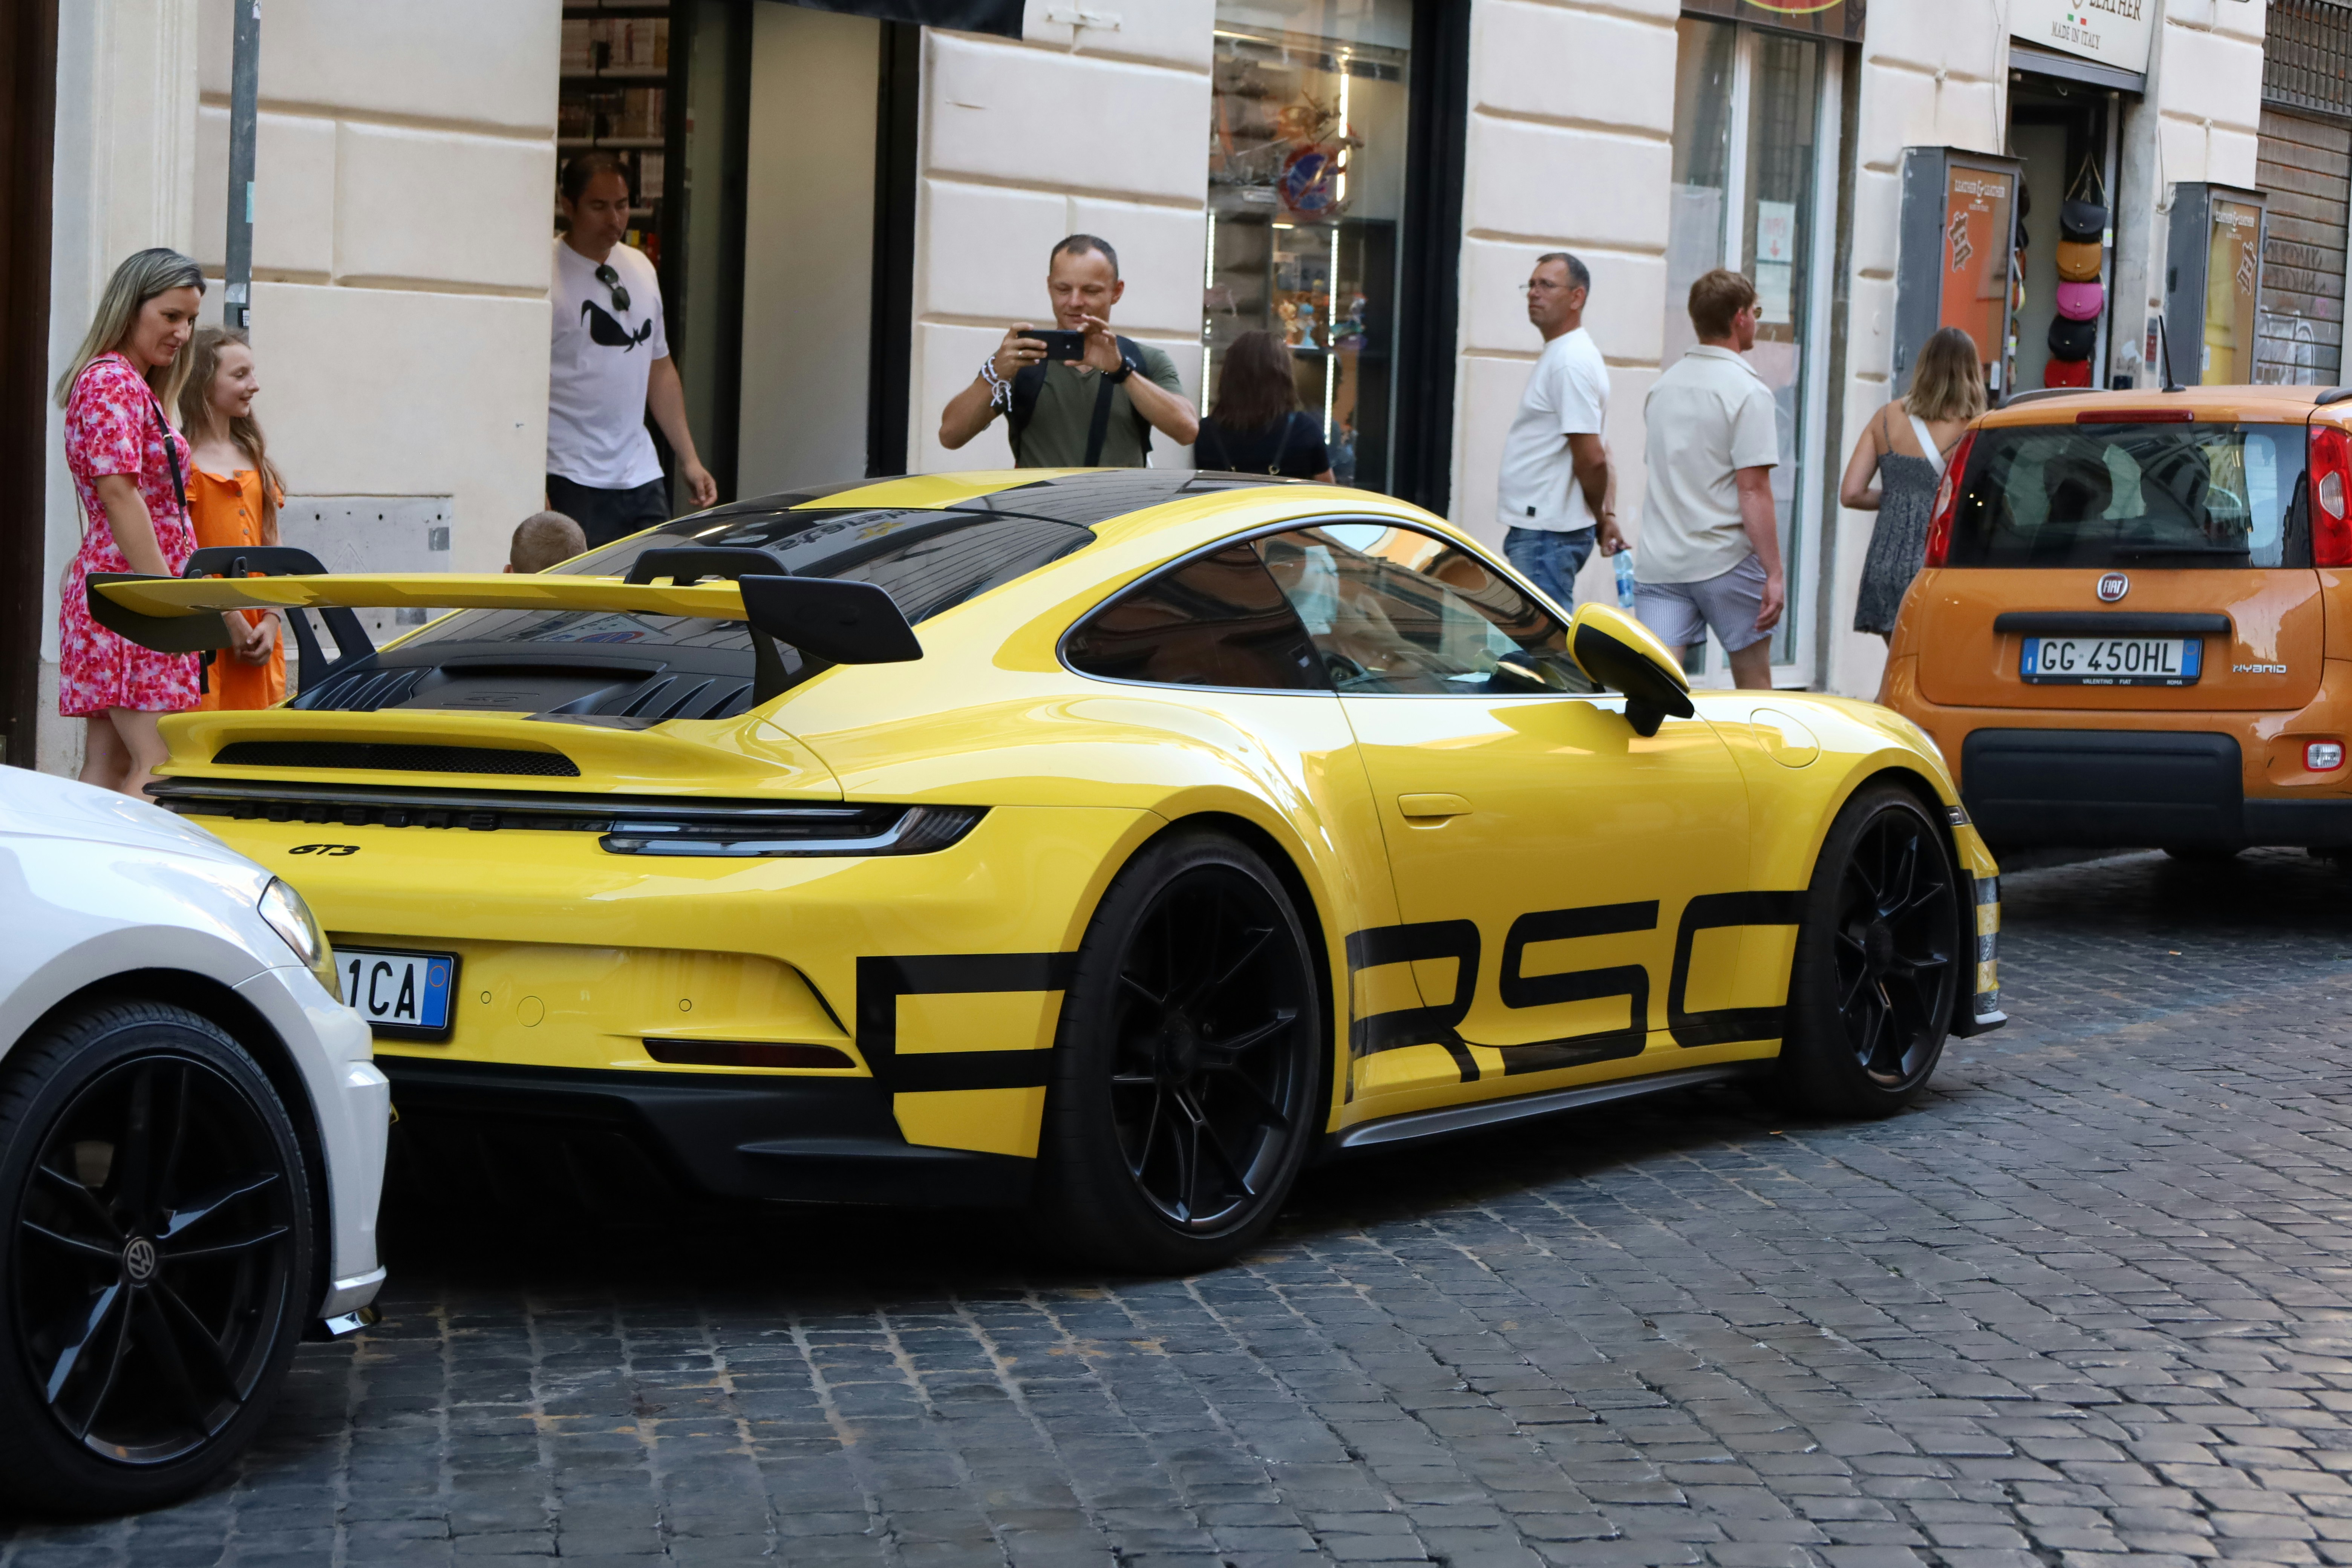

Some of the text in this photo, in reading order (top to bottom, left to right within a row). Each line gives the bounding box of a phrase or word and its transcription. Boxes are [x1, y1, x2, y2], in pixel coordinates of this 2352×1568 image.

[2051, 21, 2101, 50] MADE IN ITALY
[2102, 579, 2123, 594] FIAT
[2042, 642, 2075, 671] GG
[2087, 642, 2177, 673] 450HL
[289, 844, 361, 856] GT3
